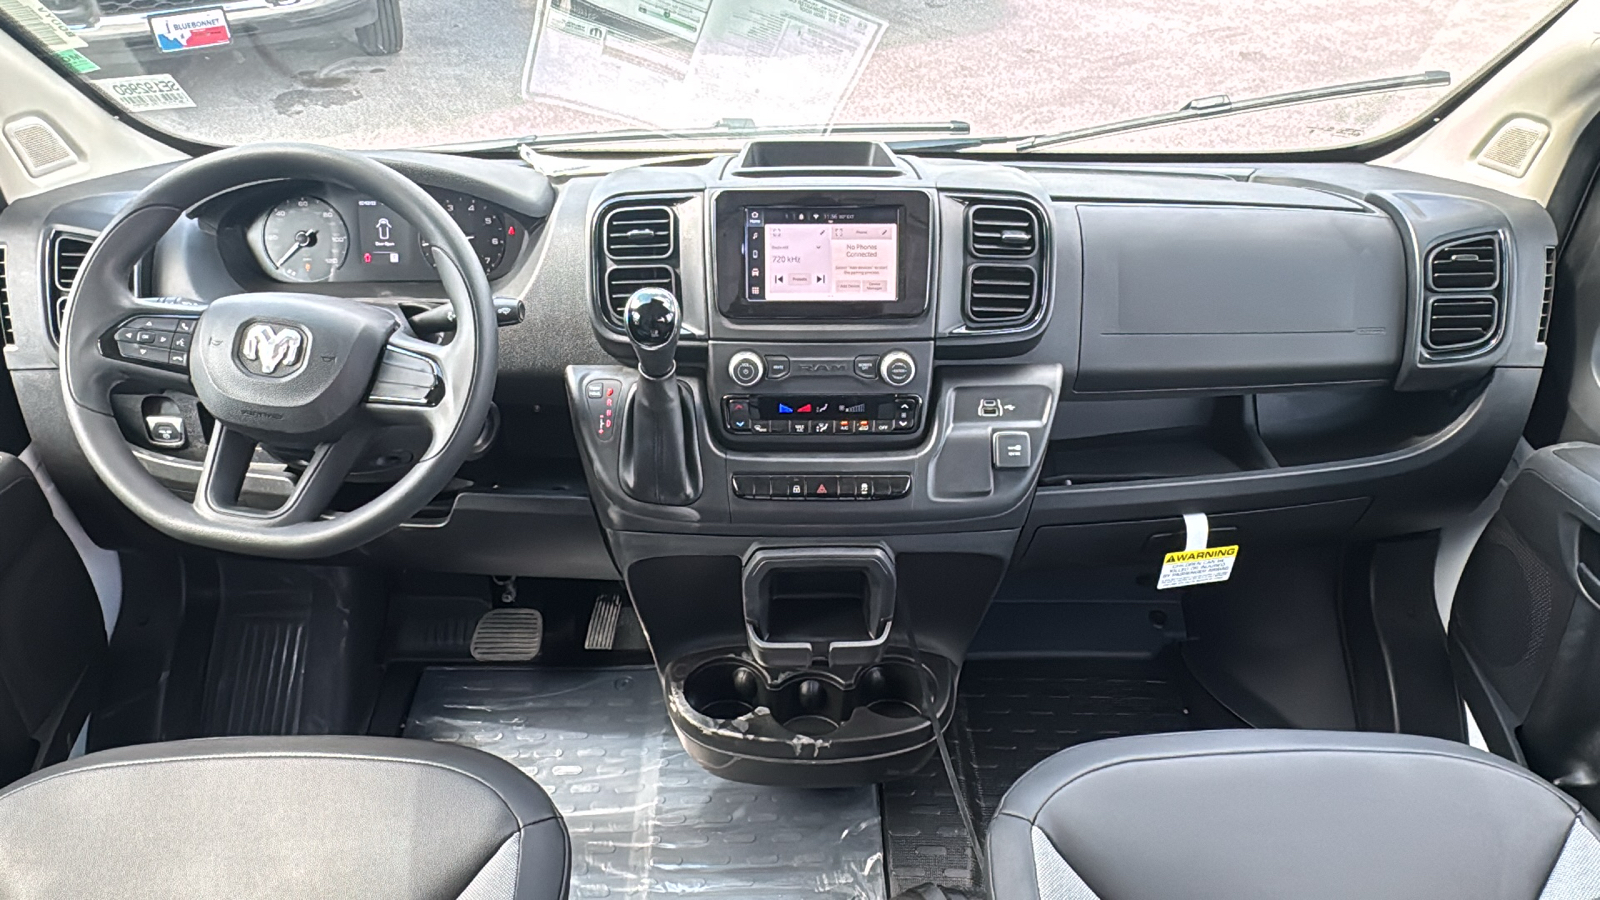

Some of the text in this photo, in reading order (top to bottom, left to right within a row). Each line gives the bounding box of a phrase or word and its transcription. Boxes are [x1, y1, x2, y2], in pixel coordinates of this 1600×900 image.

[173, 18, 220, 31] BLUEBONNET
[799, 364, 847, 372] RAM
[606, 388, 613, 396] P
[605, 419, 611, 427] D
[1176, 548, 1235, 562] WARNING
